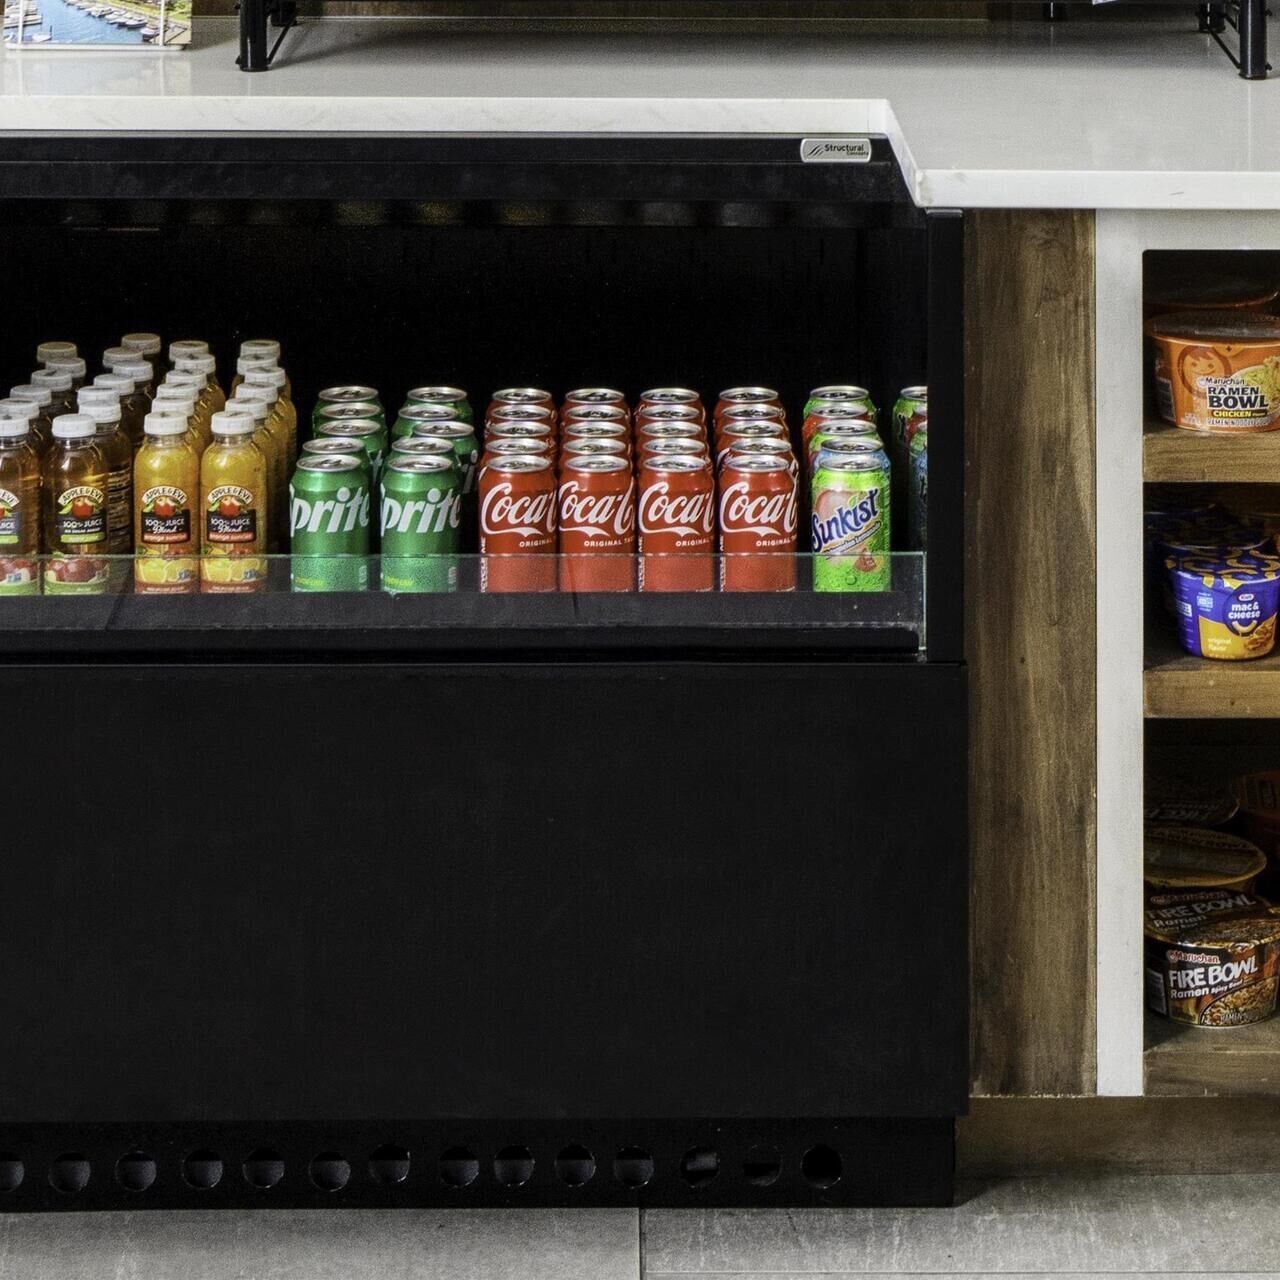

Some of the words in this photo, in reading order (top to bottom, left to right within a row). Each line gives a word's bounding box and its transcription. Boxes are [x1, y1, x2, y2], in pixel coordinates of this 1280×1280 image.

[824, 144, 865, 152] Structural
[1208, 386, 1260, 395] RAMEN
[1208, 396, 1269, 409] BOWL
[289, 483, 369, 538] prite
[380, 483, 461, 538] prite
[166, 518, 184, 526] JUICE
[232, 518, 250, 526] JUICE
[812, 488, 879, 553] Sunkist
[584, 539, 623, 548] ORIGINAL
[675, 538, 710, 548] ORIGINAL
[756, 537, 791, 547] ORIGINAL
[1231, 603, 1252, 611] mac
[1252, 601, 1259, 610] &
[1168, 967, 1206, 988] FIRE
[1208, 955, 1259, 985] BOWL
[1170, 987, 1209, 999] Ramen
